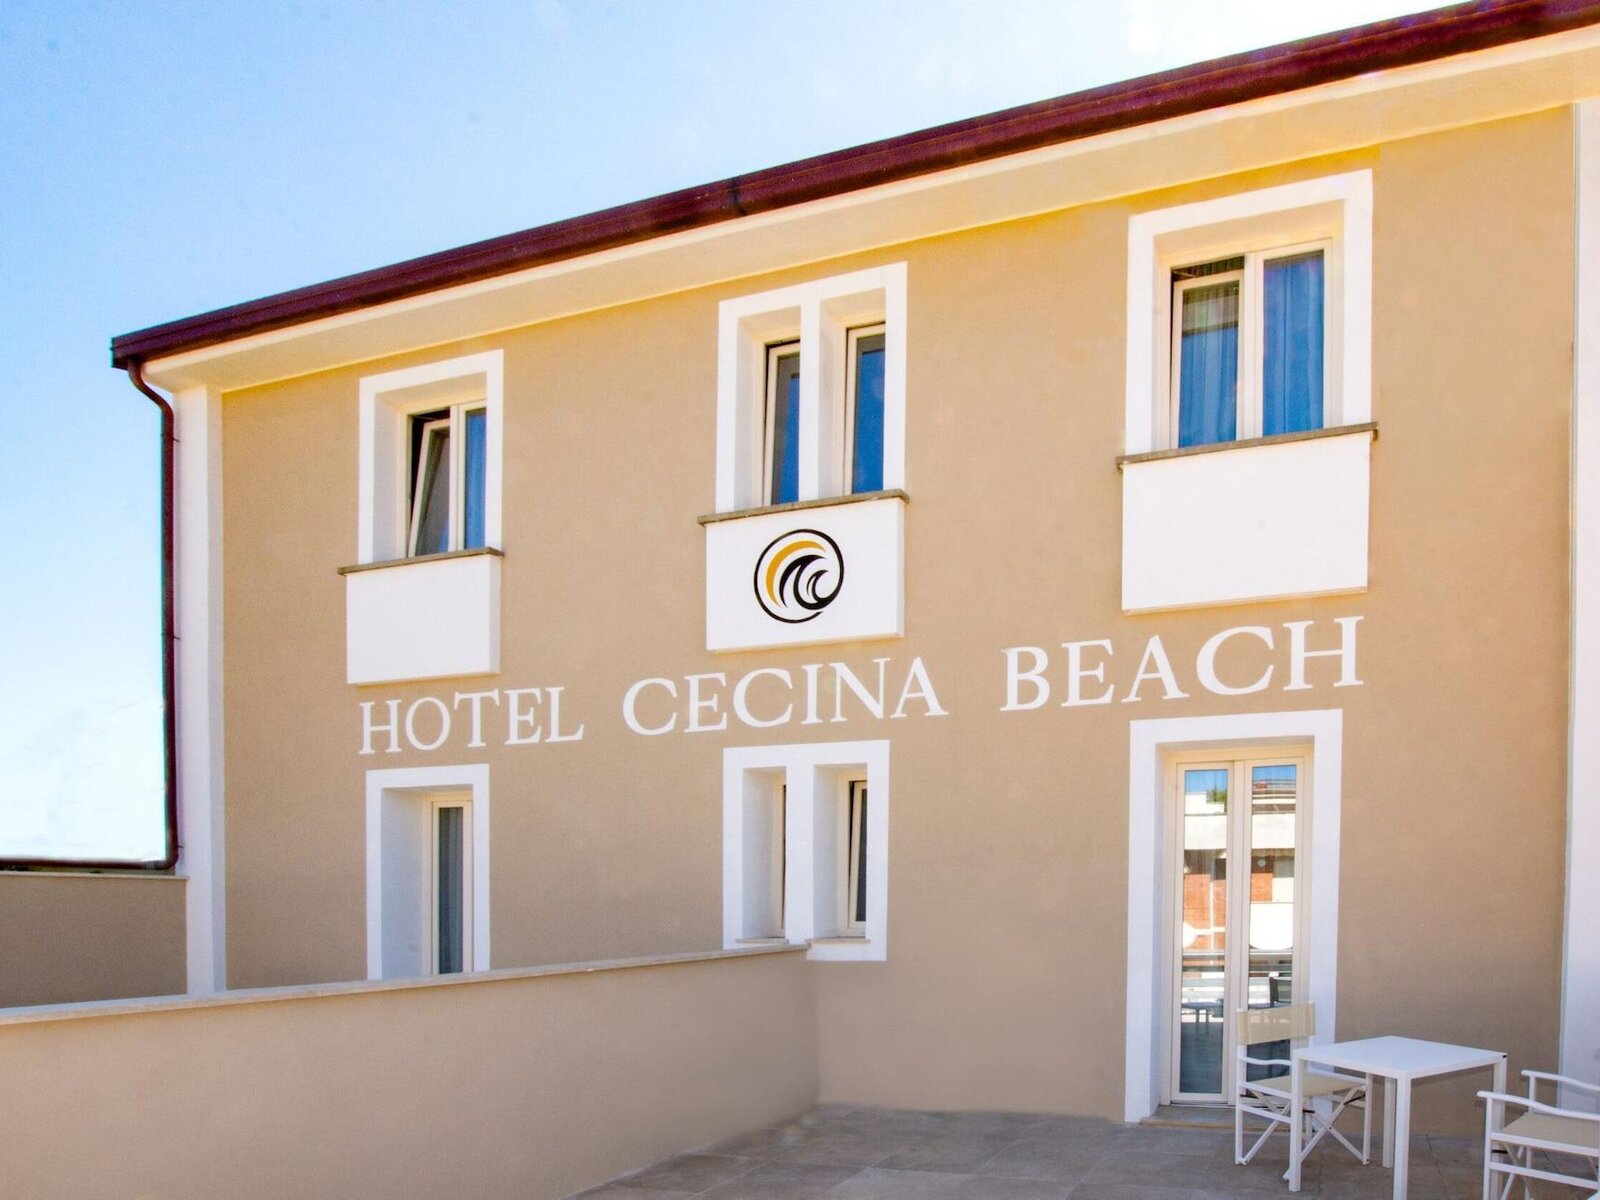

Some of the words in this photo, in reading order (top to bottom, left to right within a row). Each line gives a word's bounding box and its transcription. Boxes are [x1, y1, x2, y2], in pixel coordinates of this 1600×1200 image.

[357, 683, 586, 755] HOTEL
[621, 655, 950, 736] CECINA
[999, 615, 1365, 715] BEACH
